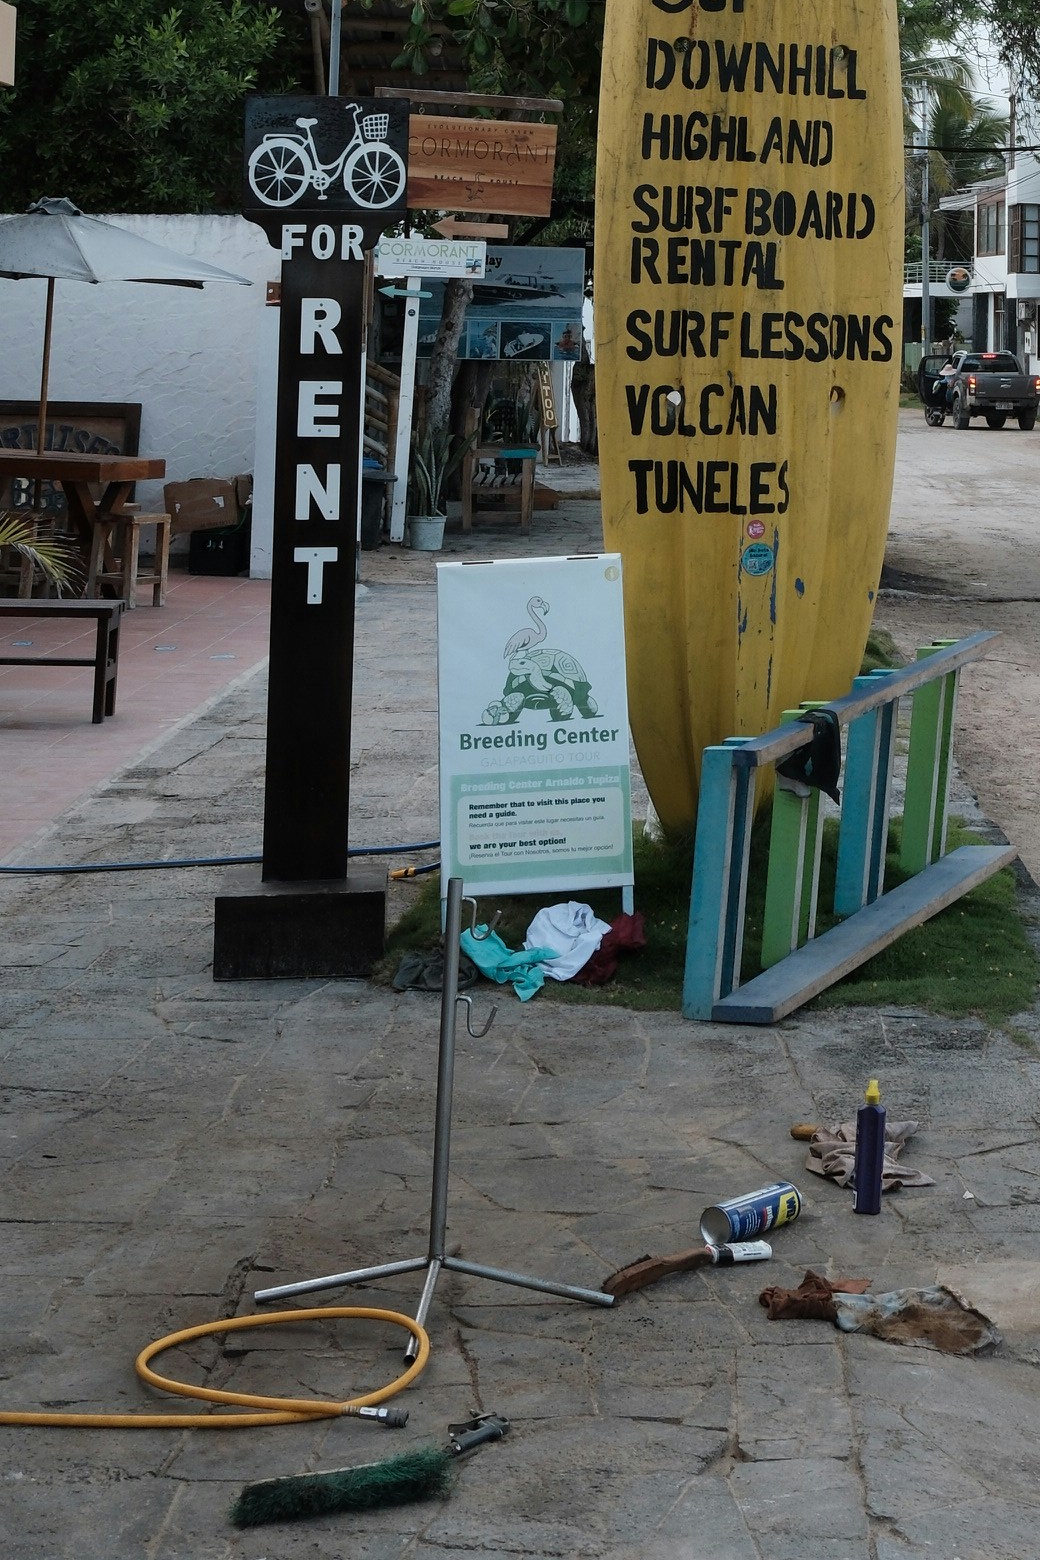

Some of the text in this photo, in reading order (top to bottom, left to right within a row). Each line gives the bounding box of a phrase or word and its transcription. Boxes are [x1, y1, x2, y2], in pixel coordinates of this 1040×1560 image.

[646, 37, 867, 100] DOWNHILL
[427, 124, 498, 133] EVOLUTIONARY
[641, 110, 834, 167] HIGHLAND
[408, 135, 556, 166] CORMORANT
[282, 224, 364, 260] FOR
[378, 243, 478, 258] CORMORANT
[631, 236, 784, 290] RENTAL
[626, 309, 894, 362] SURF LESSONS
[625, 383, 777, 437] VOLCAN
[293, 297, 343, 604] RENT
[628, 459, 790, 515] TUNELES
[460, 727, 619, 751] Breeding Center
[481, 751, 600, 768] GALAPAGUITO TOUR
[461, 775, 620, 793] Breeding Center Arnaldo Tupiza
[469, 802, 507, 811] Remember
[570, 796, 590, 806] place
[592, 796, 606, 804] you
[495, 810, 517, 819] guide.
[499, 841, 517, 850] your
[519, 839, 536, 847] best
[538, 837, 567, 847] option!
[577, 845, 592, 853] mejor
